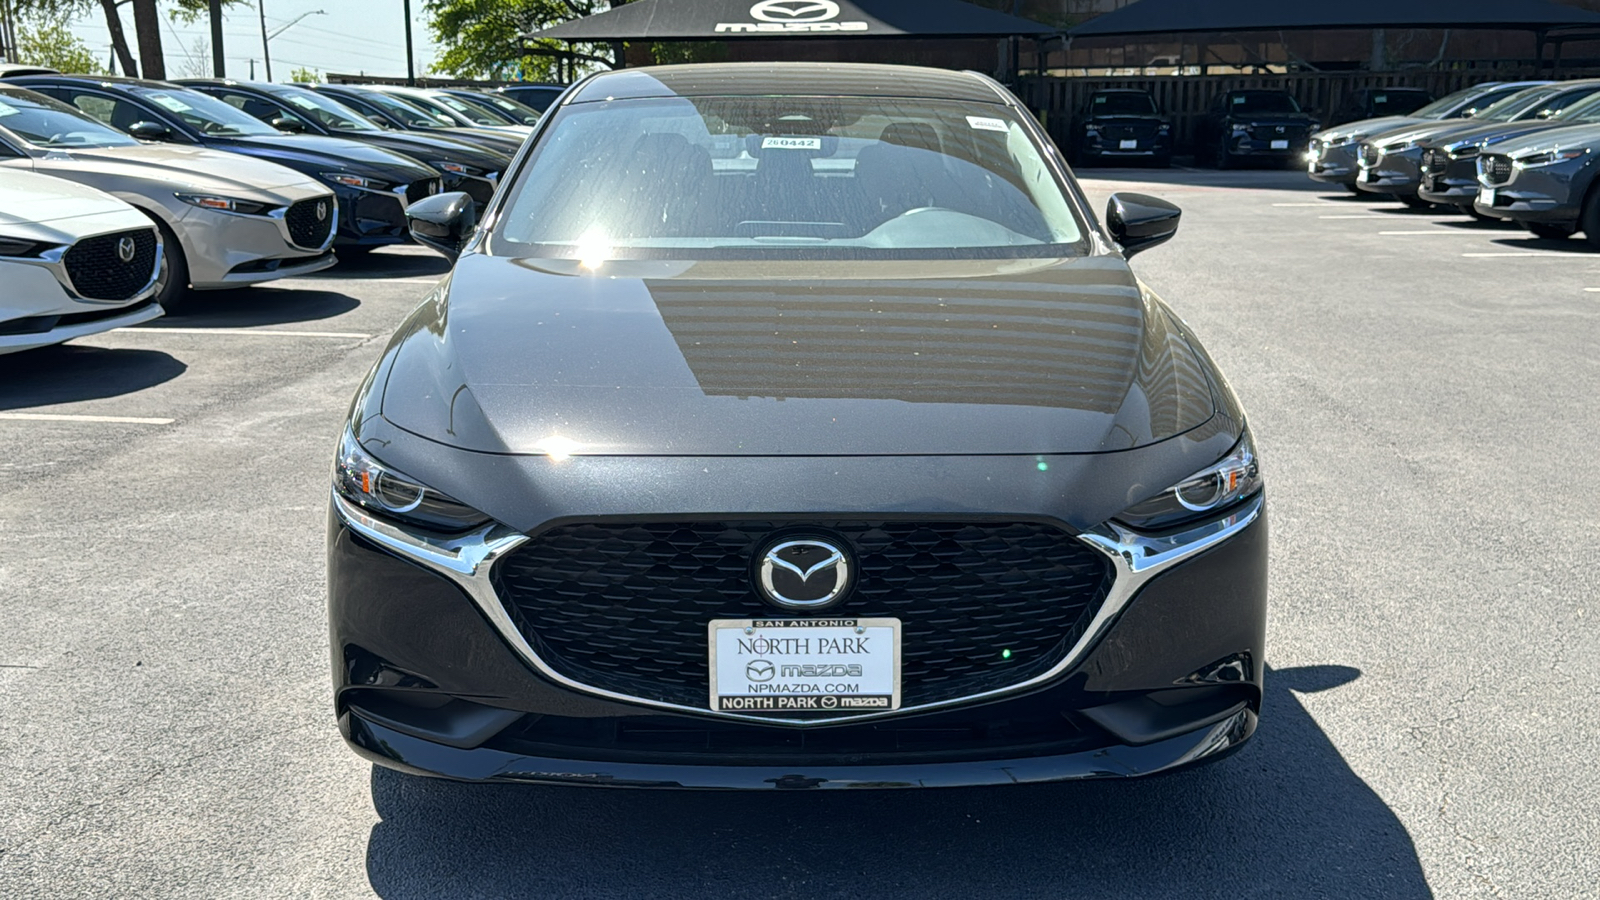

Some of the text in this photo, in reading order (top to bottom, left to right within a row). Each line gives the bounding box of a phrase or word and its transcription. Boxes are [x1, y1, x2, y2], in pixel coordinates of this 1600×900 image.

[737, 637, 870, 655] NORTH PARK
[748, 683, 859, 693] NPMAZDA.COM
[722, 697, 773, 709] NORTH
[778, 697, 818, 708] PARK
